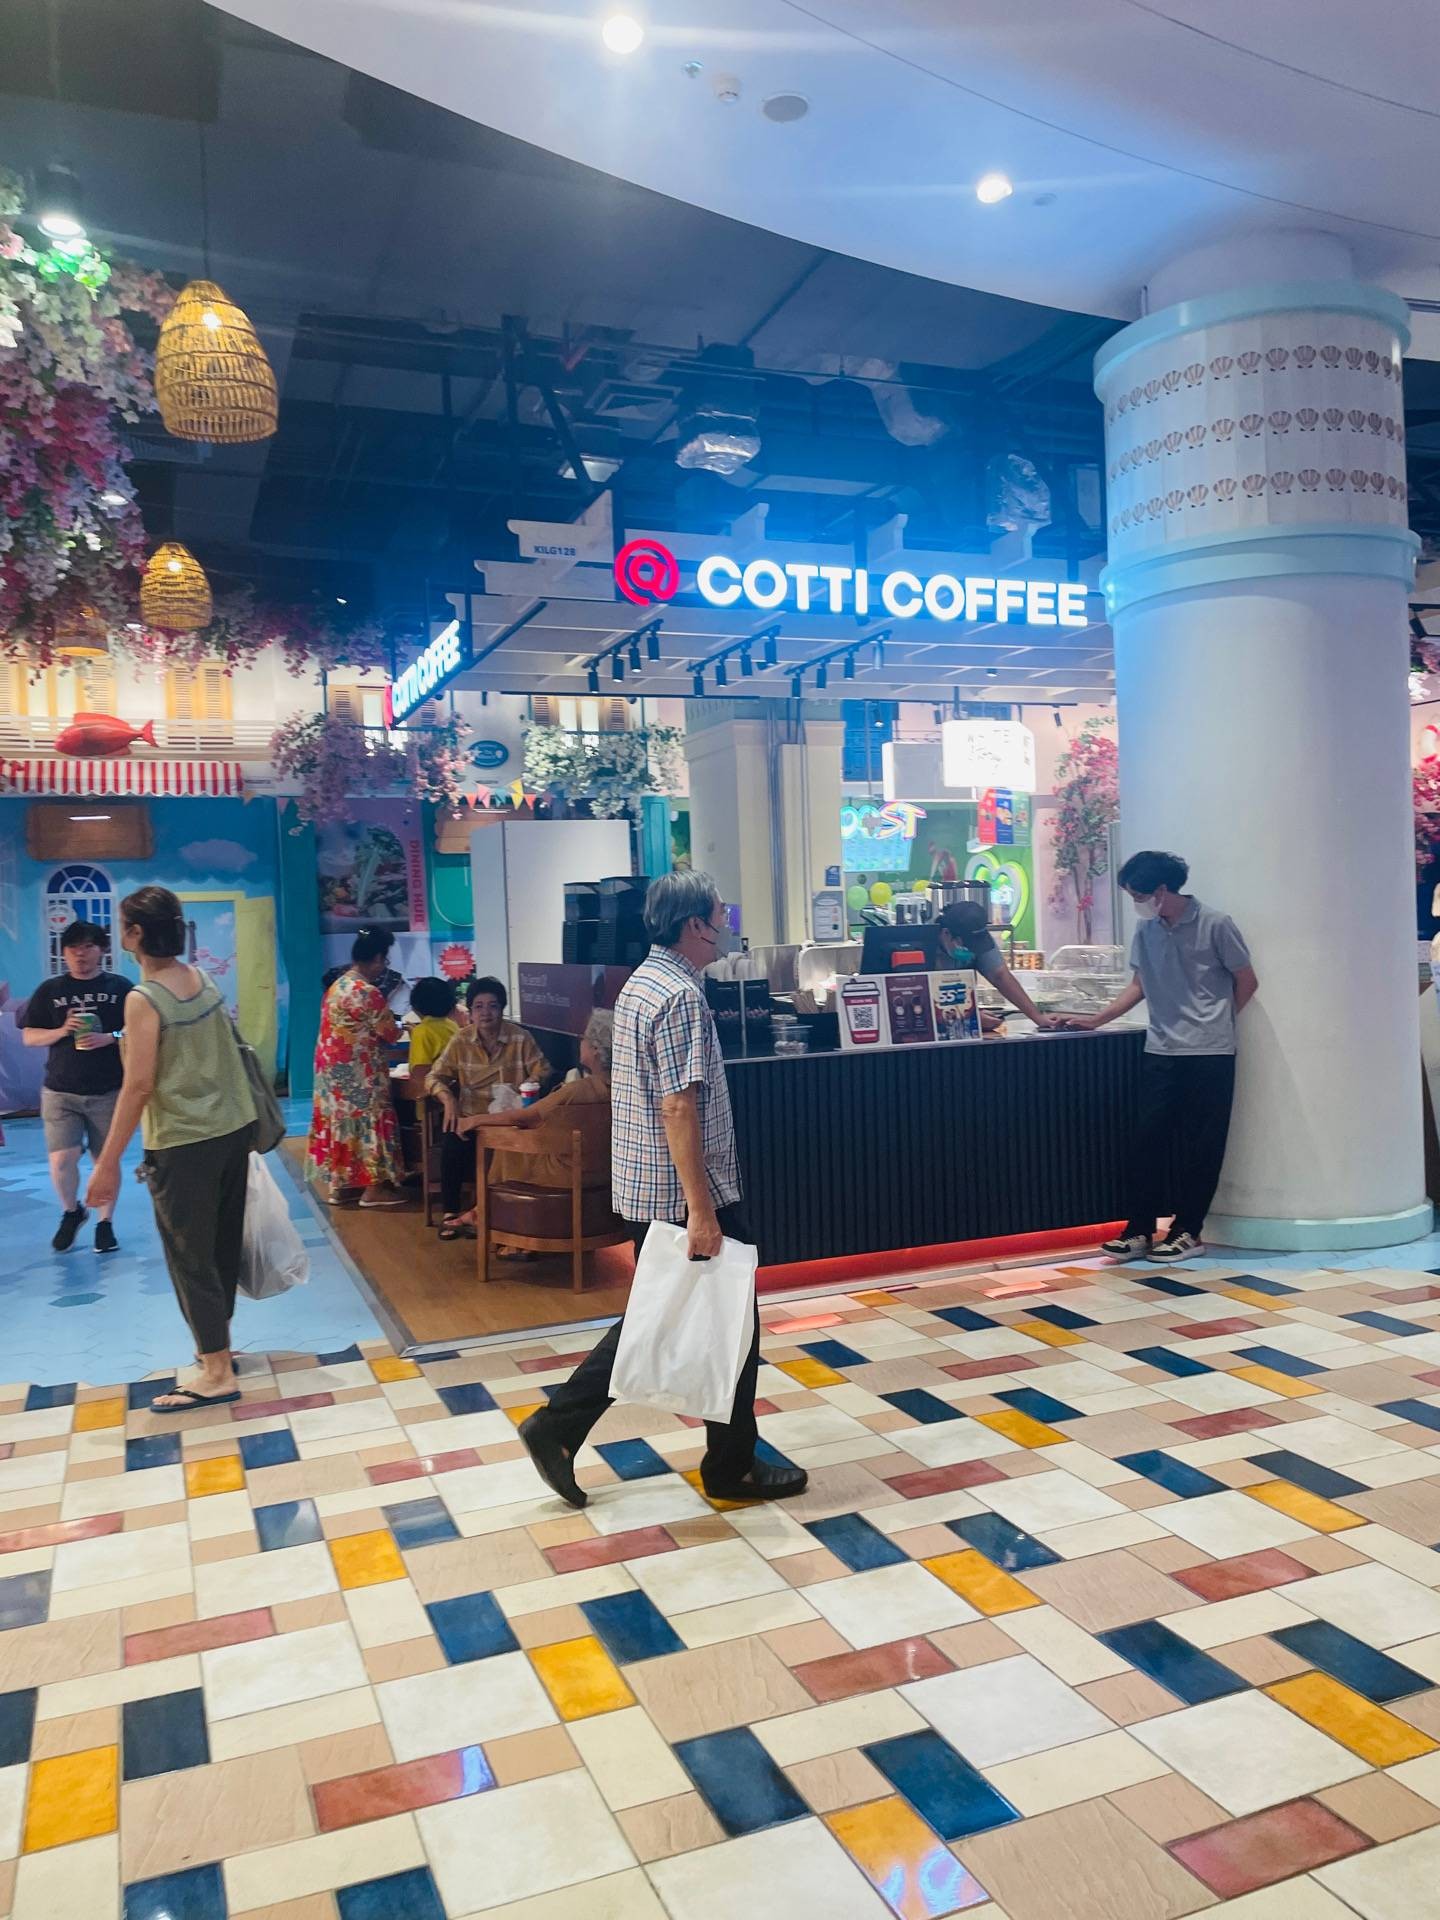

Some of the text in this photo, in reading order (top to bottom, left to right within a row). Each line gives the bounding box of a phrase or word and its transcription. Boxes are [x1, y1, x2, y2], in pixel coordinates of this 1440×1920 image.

[533, 545, 576, 556] KILG128
[697, 556, 868, 614] COTTI
[882, 571, 1089, 627] COFFEE
[410, 840, 424, 923] DINING HUB
[53, 992, 118, 1007] MARDI
